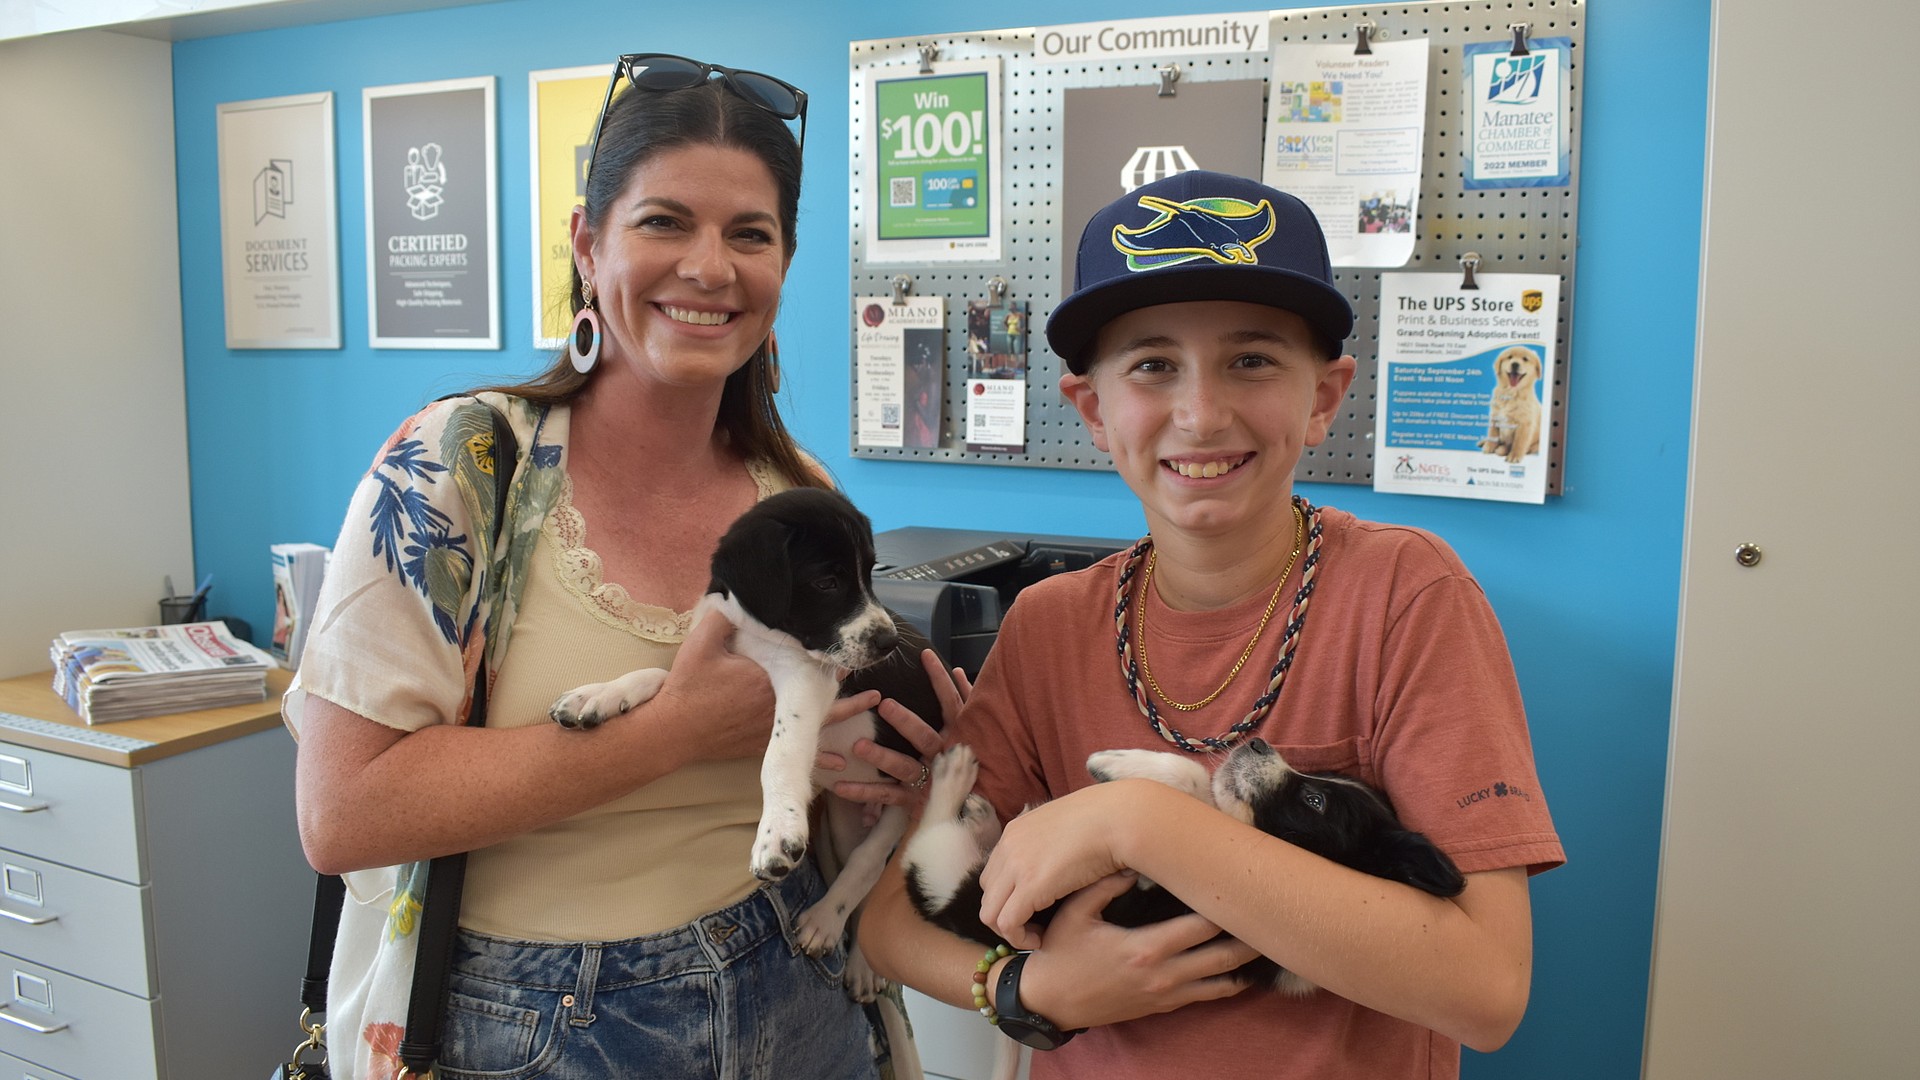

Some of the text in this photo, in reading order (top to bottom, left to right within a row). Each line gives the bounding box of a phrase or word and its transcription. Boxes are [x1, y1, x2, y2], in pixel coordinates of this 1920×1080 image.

[1043, 20, 1259, 56] Our Community
[1315, 59, 1389, 69] Volunteer Readers
[1322, 71, 1337, 80] We
[1339, 71, 1362, 79] Need
[913, 91, 949, 109] Win
[1482, 111, 1553, 127] Manatee
[881, 110, 983, 158] $100!
[1316, 135, 1333, 144] FOR
[1479, 127, 1540, 140] CHAMBER
[1476, 138, 1551, 153] COMMERCE
[1483, 160, 1548, 170] 2022 MEMBER
[245, 238, 308, 252] DOCUMENT
[388, 233, 468, 253] CERTIFIED
[246, 252, 309, 273] SERVICES
[389, 252, 468, 267] PACKING EXPERTS
[1398, 296, 1541, 312] The UPS Store ups
[888, 307, 938, 318] MIANO
[1397, 314, 1539, 327] Print & Business Services
[1397, 329, 1540, 339] Grand Opening Adoption Event!
[1394, 367, 1425, 375] Saturday
[1427, 367, 1465, 376] September
[1456, 787, 1491, 809] LUCKY
